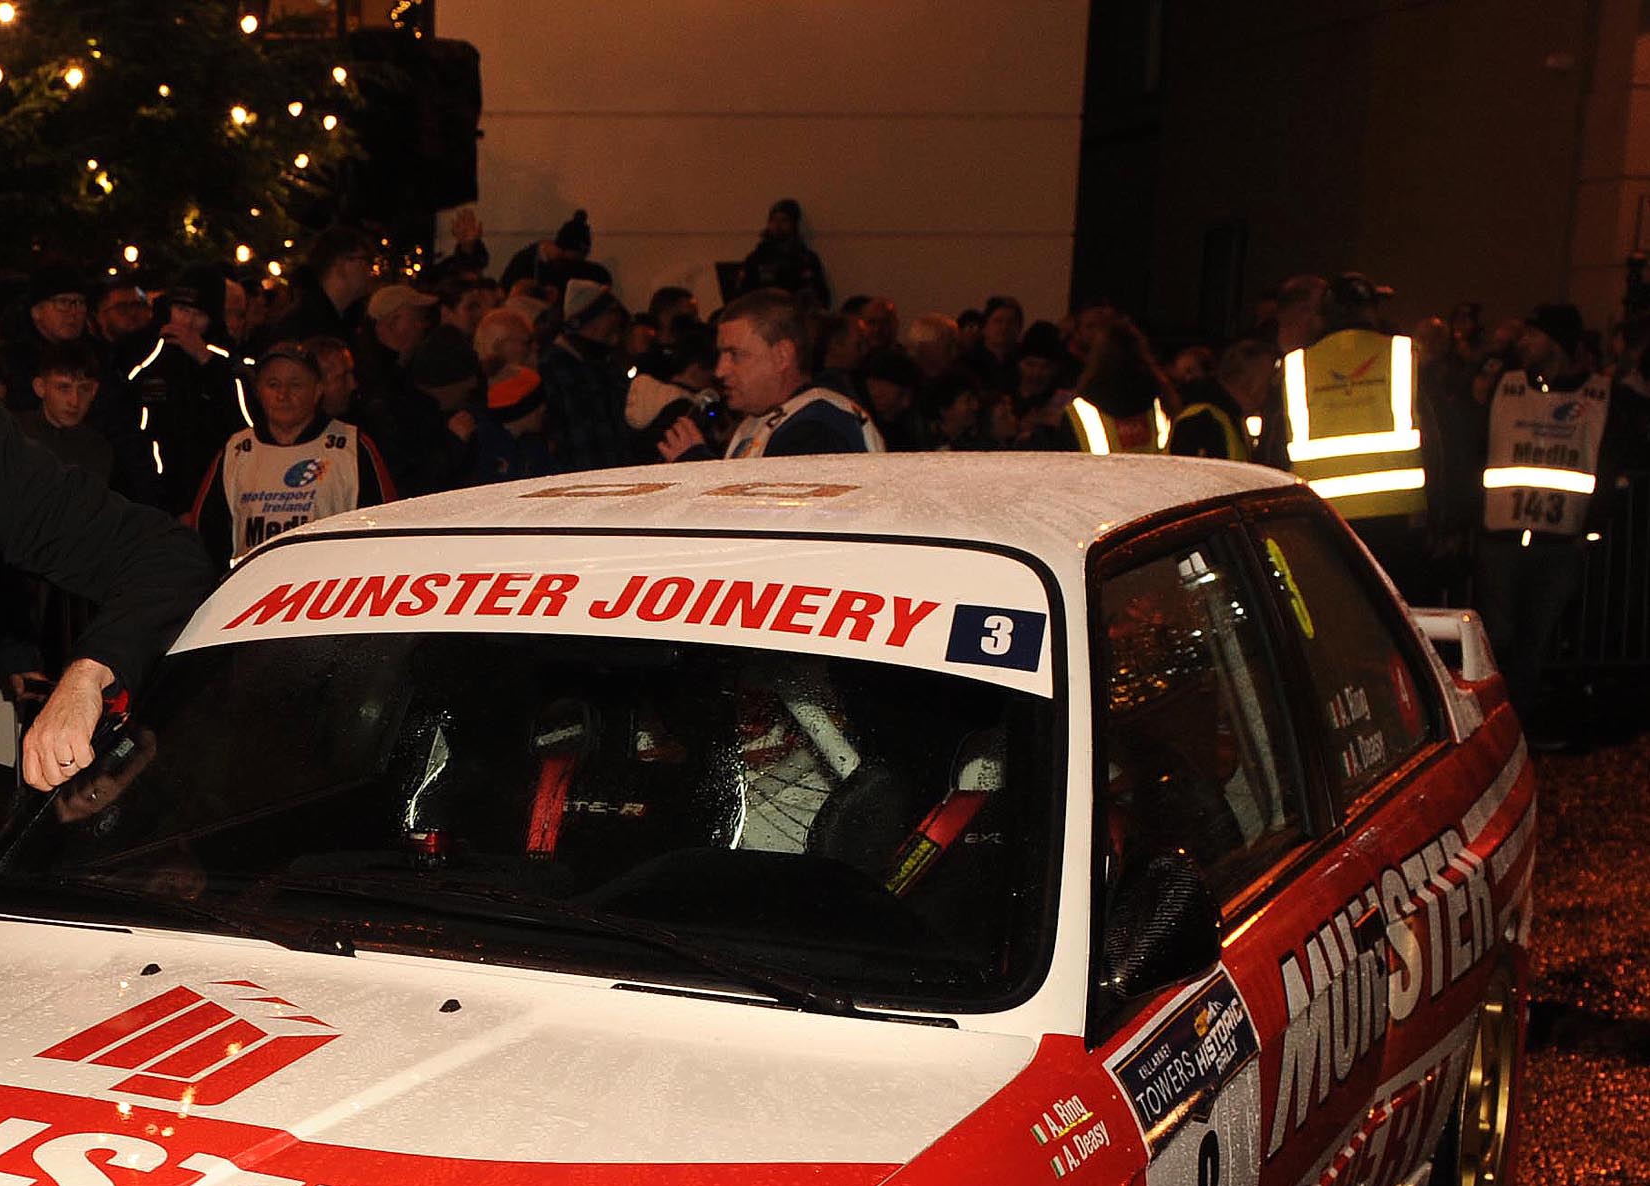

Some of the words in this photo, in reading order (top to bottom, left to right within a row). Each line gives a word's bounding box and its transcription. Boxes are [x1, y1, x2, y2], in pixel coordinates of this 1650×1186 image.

[325, 434, 347, 449] 30
[241, 490, 316, 503] Motorsport
[262, 501, 312, 513] Ireland
[1512, 490, 1565, 523] 143
[223, 571, 581, 630] MUNSTER
[588, 574, 942, 648] JOINERY
[980, 615, 1014, 656] 3
[1135, 1050, 1196, 1122] TOWERS
[1194, 997, 1244, 1077] HISTORIC
[1137, 1042, 1173, 1080] KILLARNEY
[1214, 1034, 1238, 1075] RALLY
[1062, 1144, 1081, 1173] A.
[1072, 1119, 1111, 1161] Deasy
